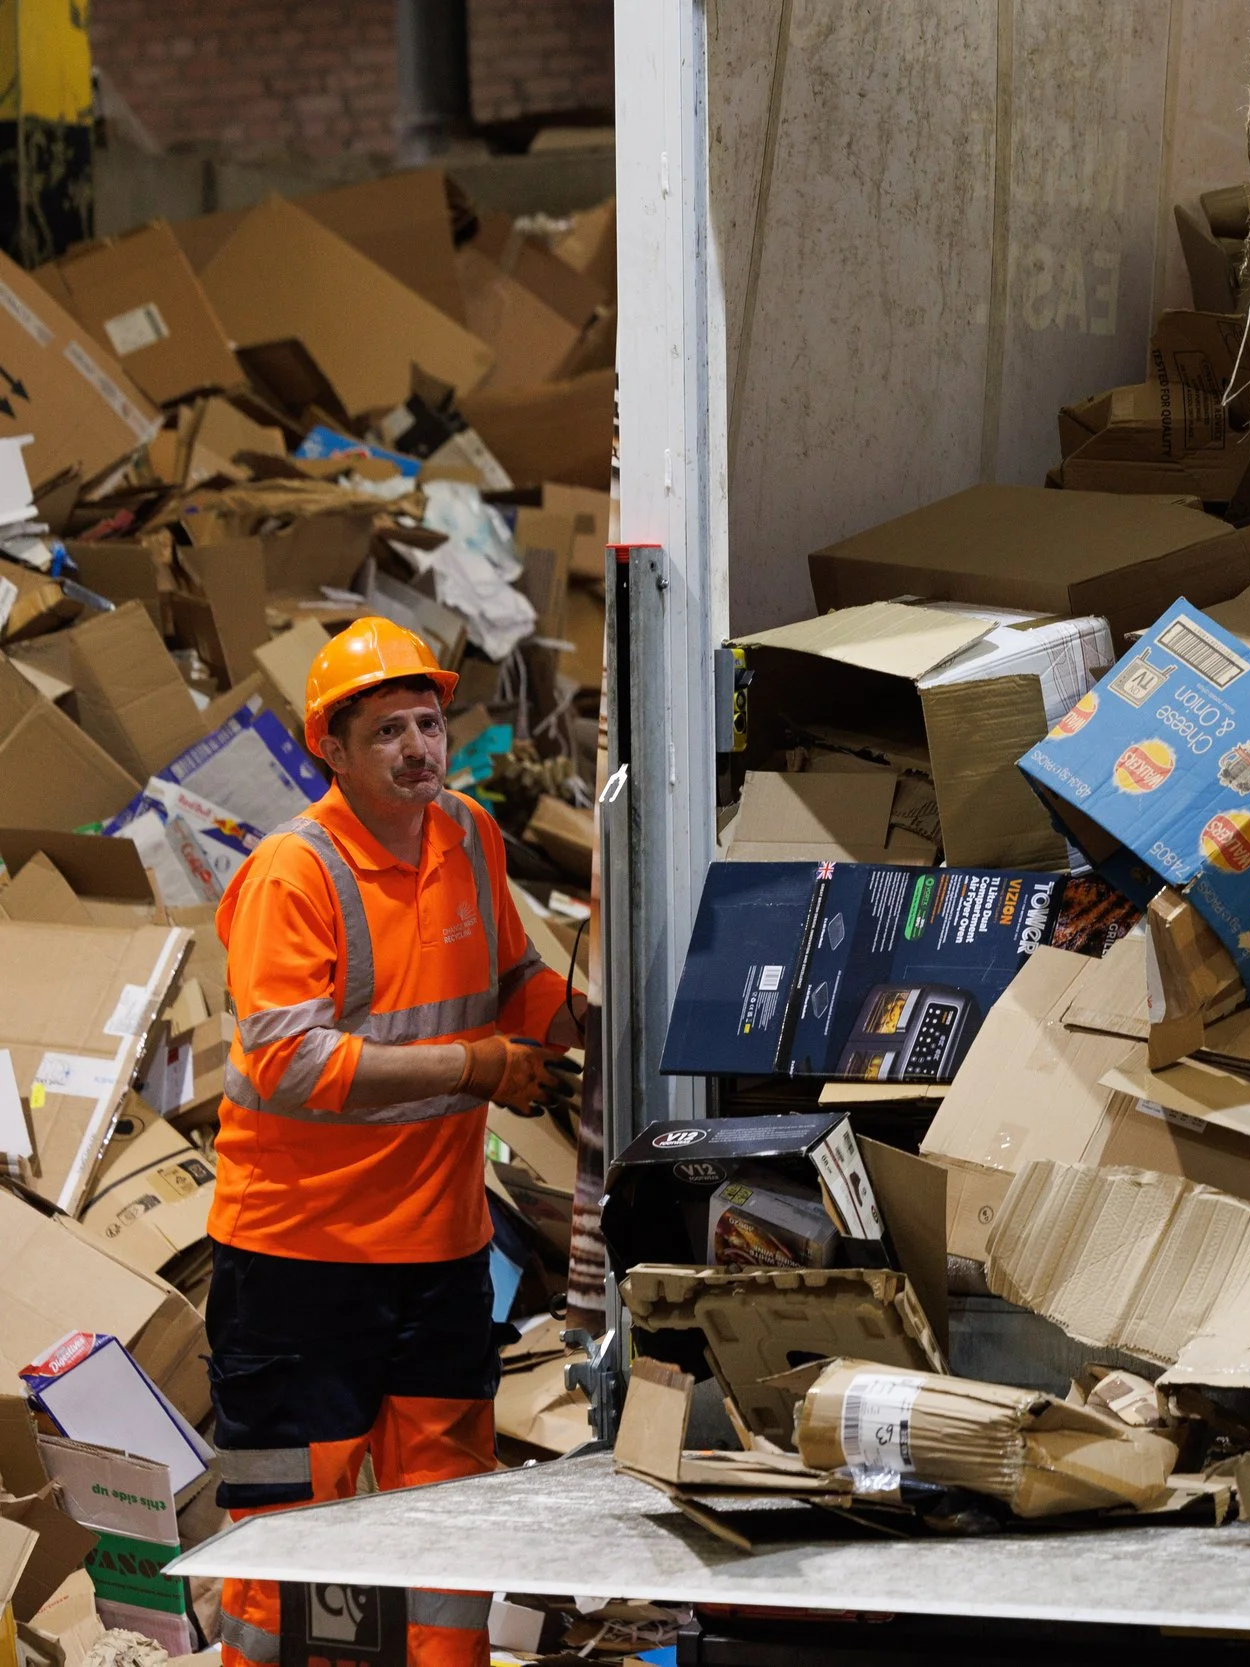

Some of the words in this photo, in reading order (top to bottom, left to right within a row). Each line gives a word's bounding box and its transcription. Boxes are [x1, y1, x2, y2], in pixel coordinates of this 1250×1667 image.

[1152, 350, 1169, 386] TESTED
[1160, 388, 1170, 408] FOR
[1160, 409, 1172, 457] QUALITY
[1133, 670, 1152, 690] TV
[1174, 685, 1220, 726] Onion
[1155, 705, 1212, 754] Cheese
[1216, 717, 1236, 737] &
[1120, 752, 1166, 791] WALKERS
[1150, 841, 1192, 879] 74805
[968, 875, 980, 892] Air
[990, 876, 1001, 886] 11
[961, 890, 977, 917] Fryer
[965, 875, 990, 944] Compartment
[986, 886, 998, 910] Litre
[999, 878, 1023, 926] VIZION
[978, 909, 993, 933] Dual
[1016, 880, 1056, 955] TOWER
[955, 917, 969, 944] Oven
[667, 1131, 700, 1143] V12
[680, 1163, 718, 1177] V12
[91, 1483, 110, 1498] up
[112, 1488, 137, 1506] side
[139, 1496, 168, 1512] this
